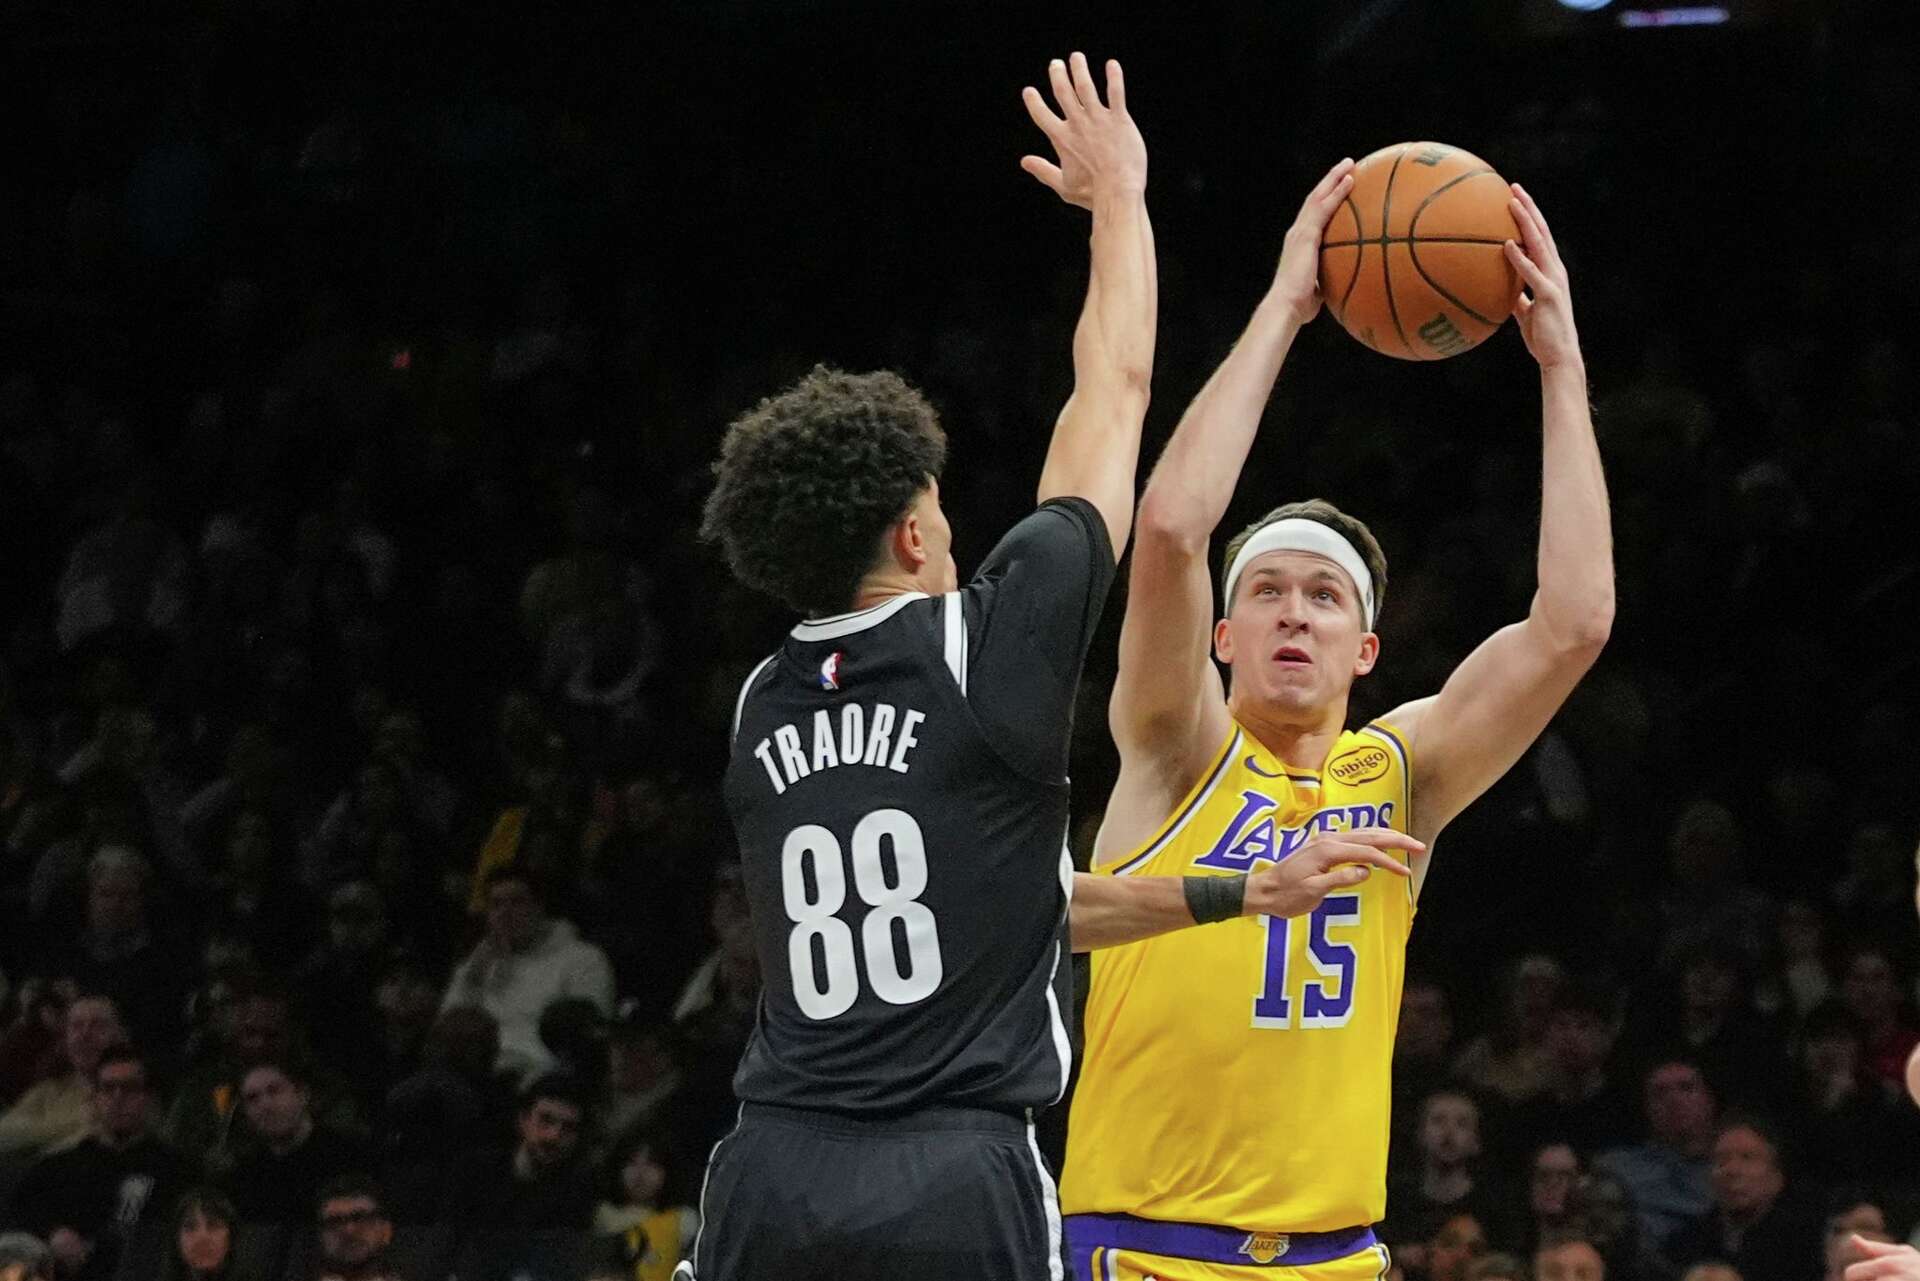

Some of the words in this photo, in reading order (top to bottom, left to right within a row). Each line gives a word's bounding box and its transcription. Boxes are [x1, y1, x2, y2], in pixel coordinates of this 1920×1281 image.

[754, 702, 927, 795] TRAORE
[1331, 752, 1385, 778] bibigo
[781, 807, 944, 1021] 88
[1250, 891, 1361, 1030] 15
